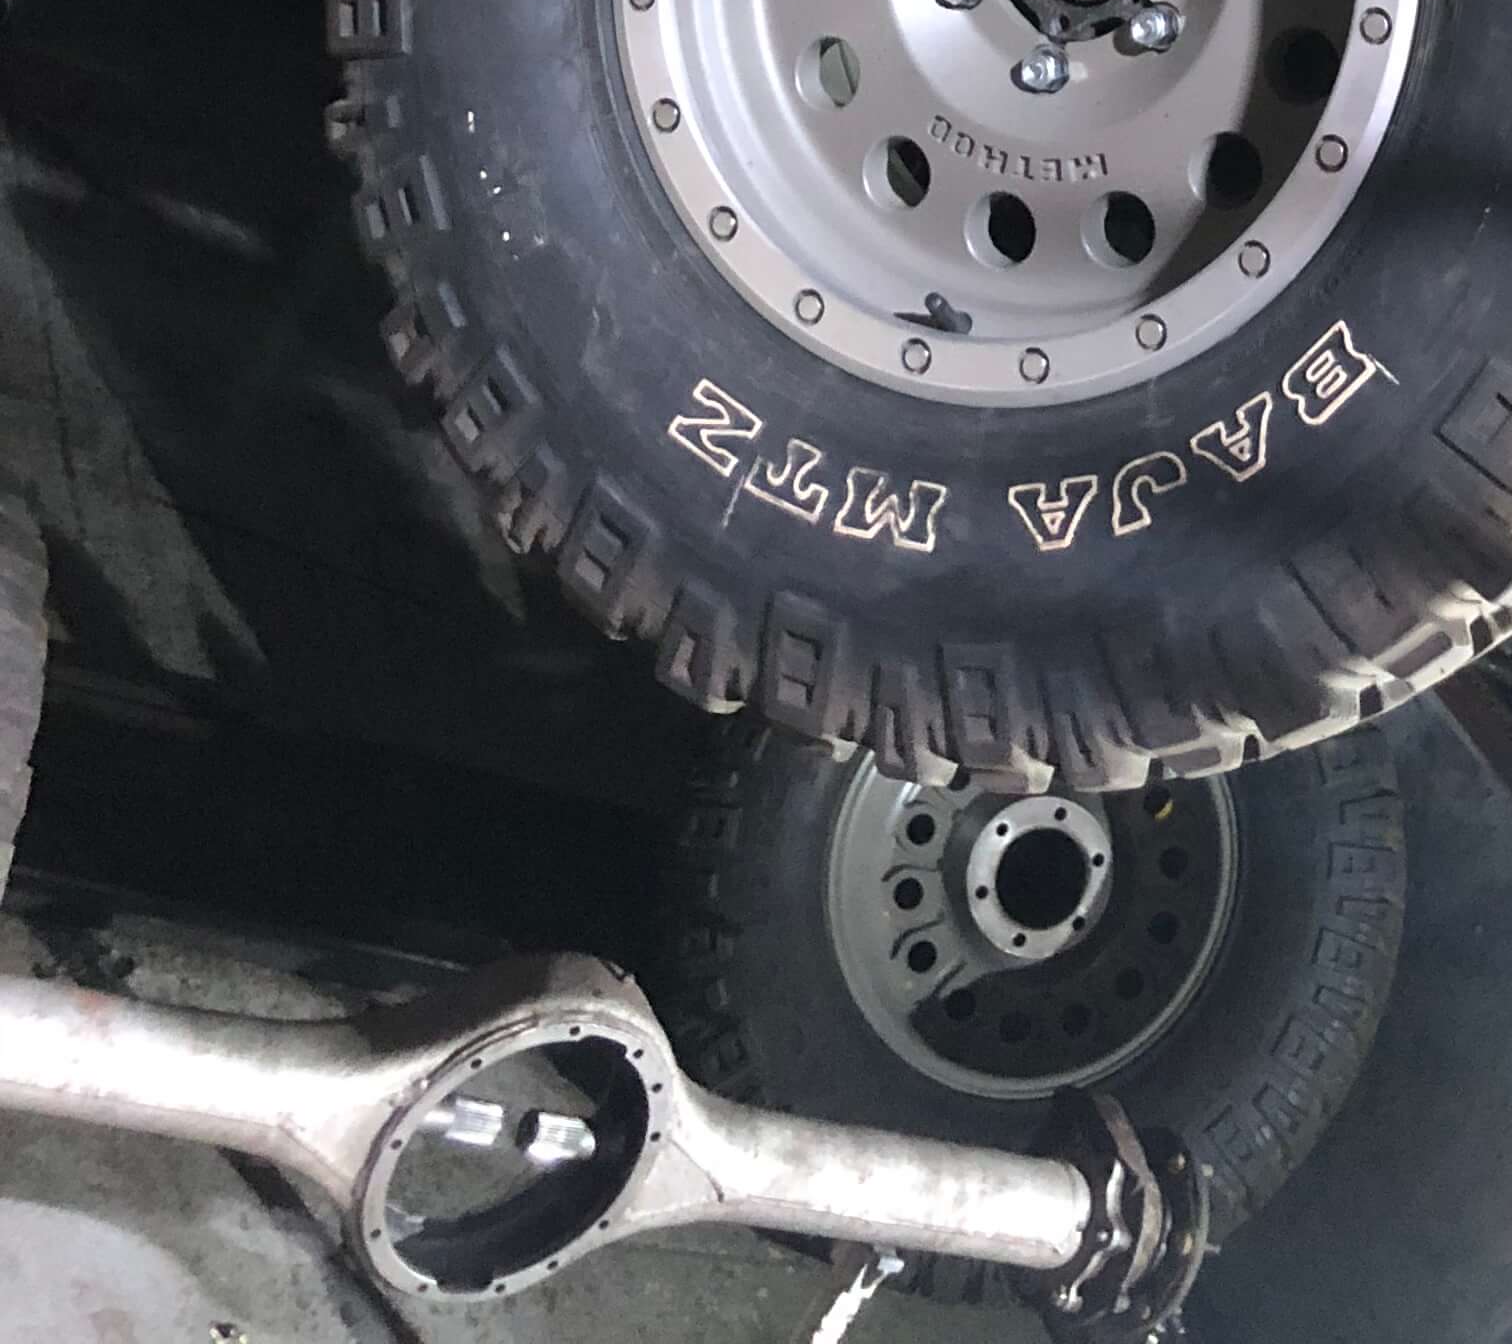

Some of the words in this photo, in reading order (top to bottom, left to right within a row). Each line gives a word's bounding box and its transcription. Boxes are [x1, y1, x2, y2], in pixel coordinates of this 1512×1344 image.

[927, 113, 1109, 183] METHOD
[668, 378, 948, 552] MTZ
[1007, 319, 1376, 551] BAJA
